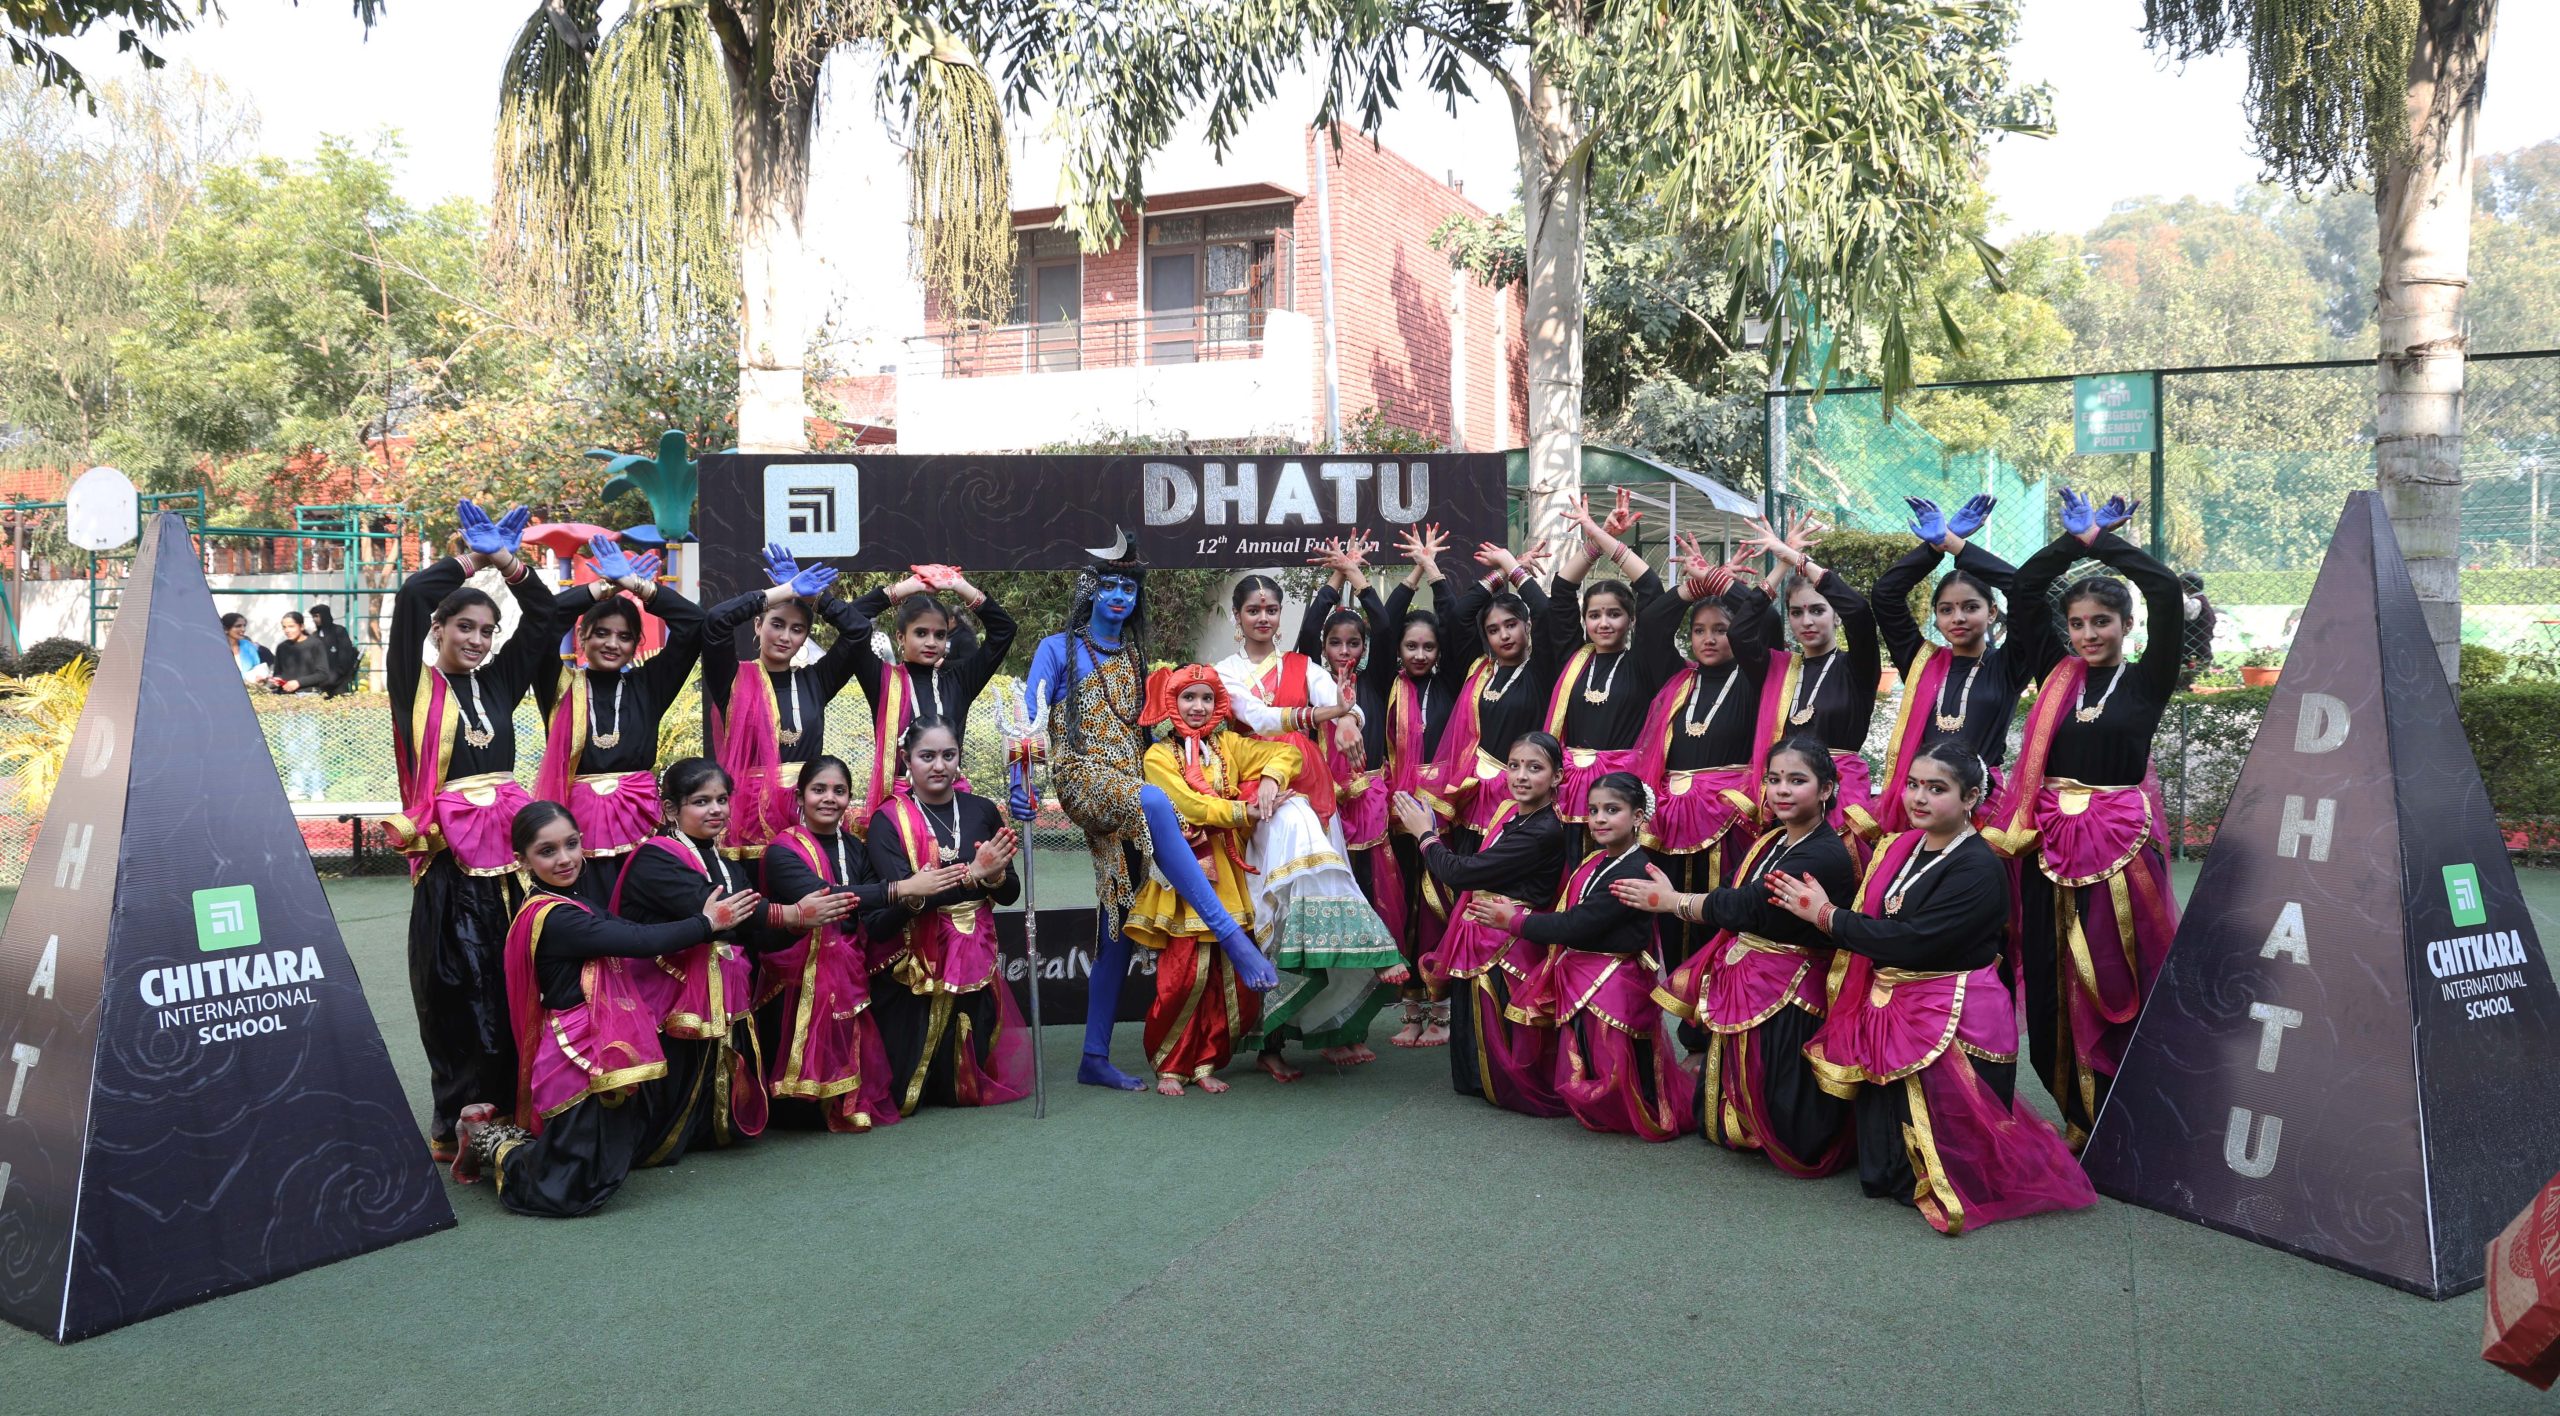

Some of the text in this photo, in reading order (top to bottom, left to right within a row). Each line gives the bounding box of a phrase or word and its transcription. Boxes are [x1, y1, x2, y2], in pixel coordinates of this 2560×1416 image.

[2093, 435, 2136, 447] POINT 1
[1143, 462, 1430, 526] DHATU
[1196, 535, 1228, 554] 12th
[1235, 537, 1300, 554] Annual
[2426, 929, 2528, 979] CHITKARA
[139, 946, 325, 1007] CHITKARA
[2441, 970, 2527, 1001] INTERNATIONAL
[158, 986, 317, 1029] INTERNATIONAL
[2466, 995, 2515, 1021] SCHOOL
[198, 1014, 287, 1045] SCHOOL
